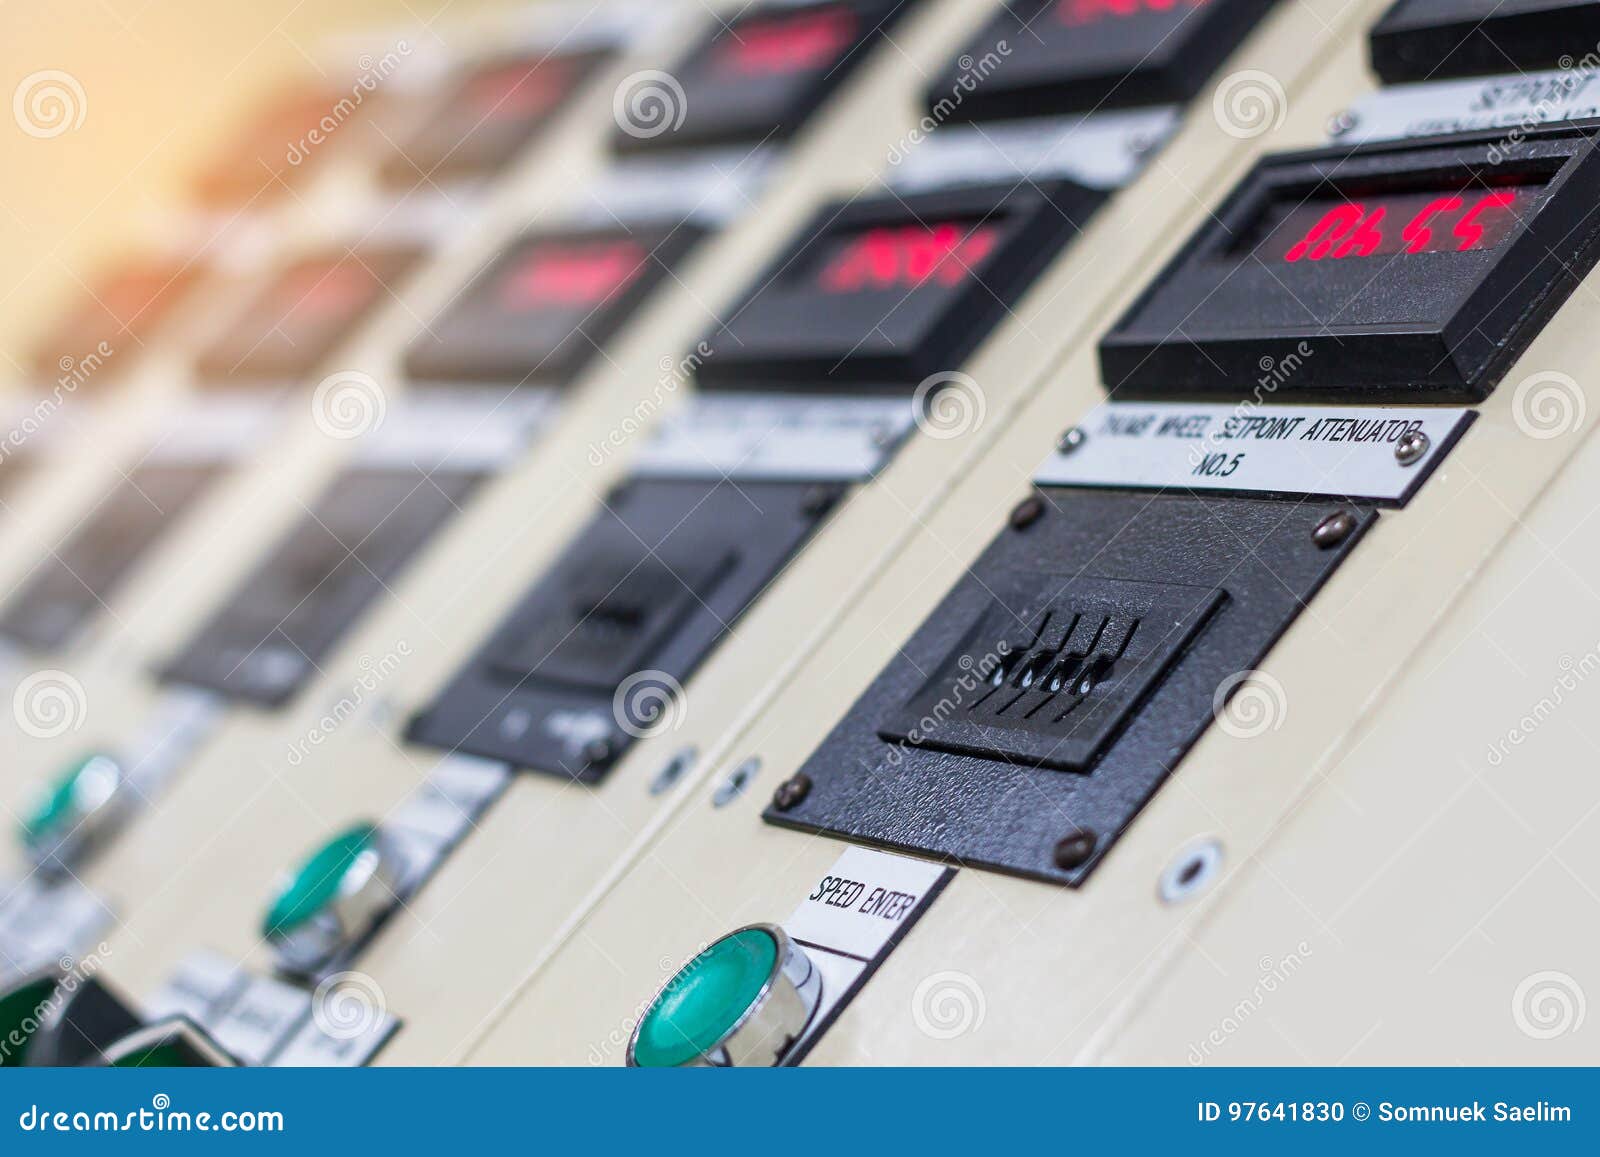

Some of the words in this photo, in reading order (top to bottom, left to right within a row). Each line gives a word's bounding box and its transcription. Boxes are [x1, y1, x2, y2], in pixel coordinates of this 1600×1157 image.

[1213, 416, 1305, 440] SETPOINT
[1192, 453, 1245, 477] NO.5
[809, 875, 866, 909] SPEED
[858, 887, 916, 921] ENTER
